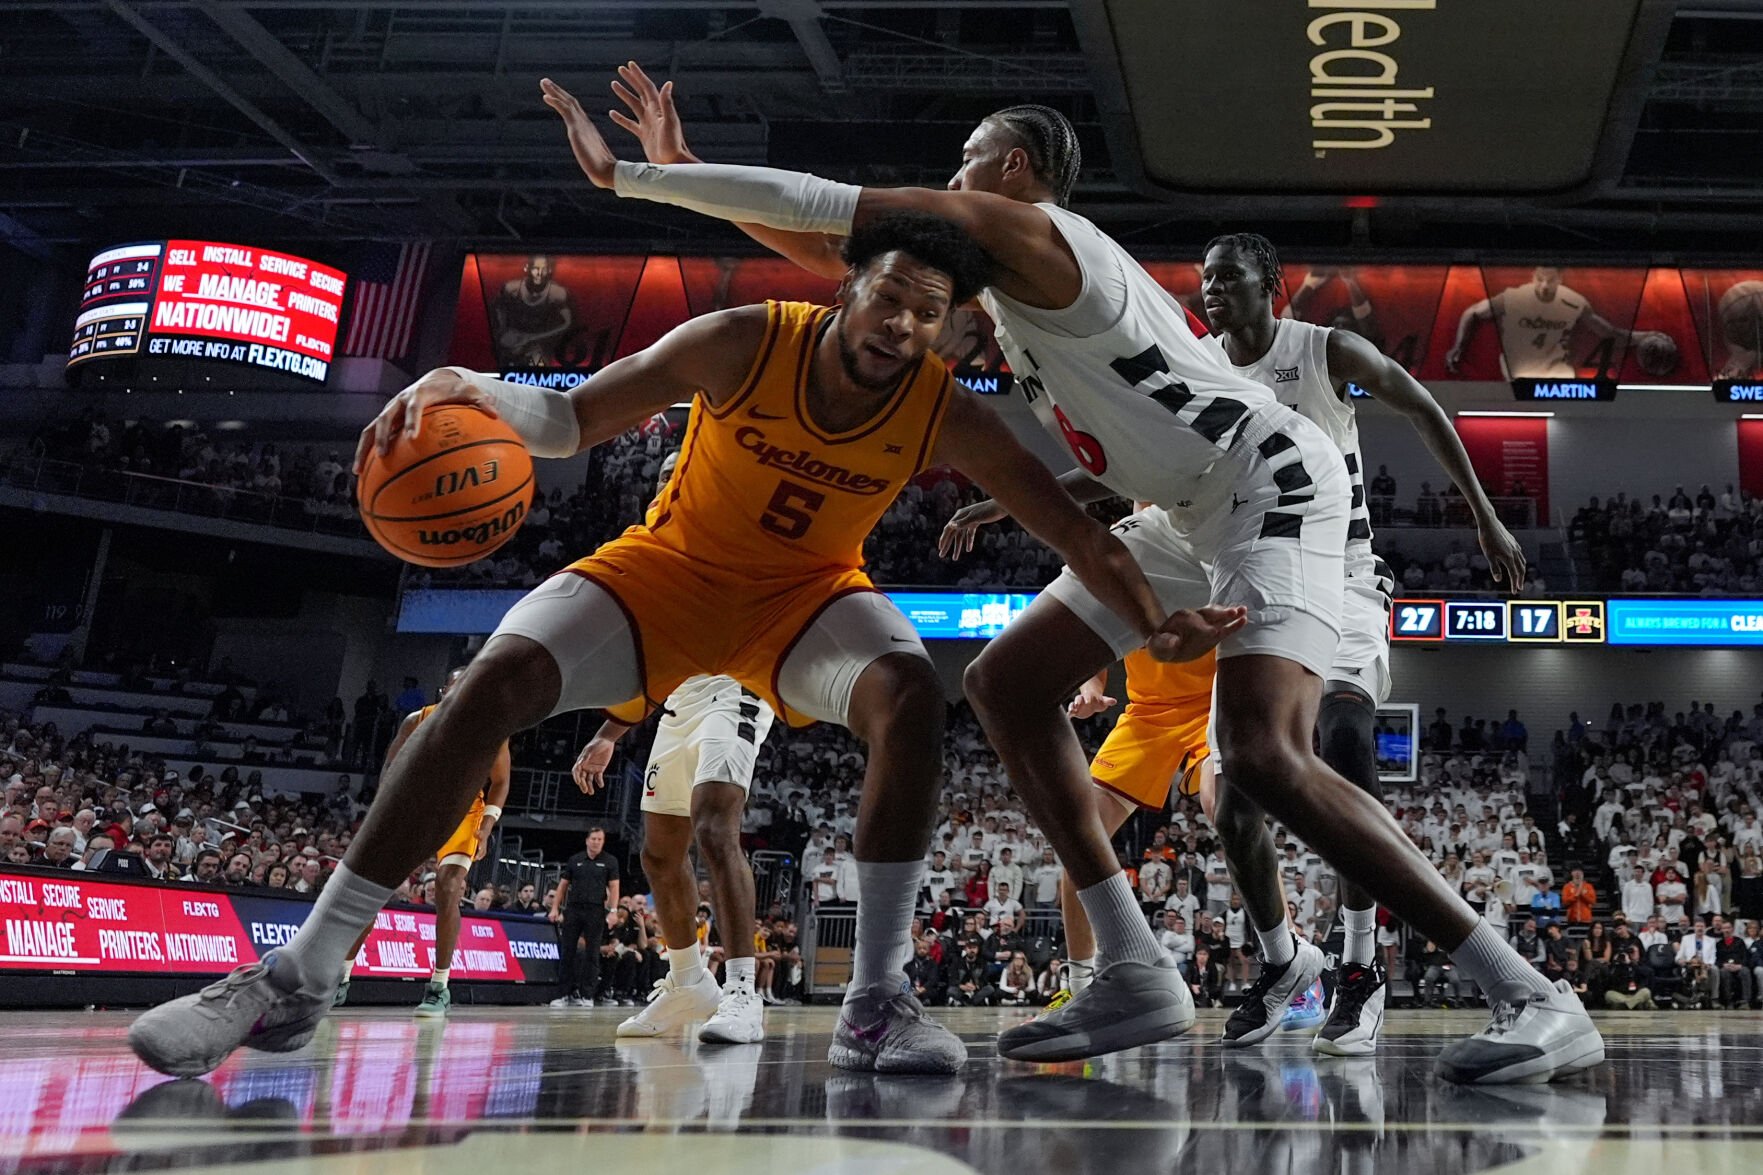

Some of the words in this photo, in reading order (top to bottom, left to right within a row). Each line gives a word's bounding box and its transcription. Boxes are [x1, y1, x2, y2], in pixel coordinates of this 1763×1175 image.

[1306, 0, 1437, 149] ealth
[167, 249, 197, 266] SELL
[202, 245, 253, 267] INSTALL
[259, 255, 308, 280] SERVICE
[309, 270, 344, 297] SECURE
[163, 274, 186, 292] WE
[198, 273, 282, 308] MANAGE
[287, 291, 338, 324] PRINTERS,
[155, 301, 291, 342] NATIONWIDE!
[148, 338, 171, 354] GET
[171, 339, 205, 356] MORE
[204, 342, 230, 359] INFO
[230, 345, 247, 361] AT
[247, 343, 328, 382] FLEXTG.COM
[1533, 383, 1597, 398] MARTIN
[1730, 385, 1763, 400] SWE
[735, 426, 890, 496] Cyclones
[418, 500, 525, 545] Wilson
[759, 479, 826, 540] 5
[1400, 607, 1435, 631] 27
[1456, 610, 1496, 630] 7:18
[1520, 609, 1552, 632] 17
[42, 883, 82, 908] SECURE
[86, 897, 128, 921] SERVICE
[183, 900, 220, 918] FLEXTG
[6, 919, 79, 957] MANAGE
[98, 929, 165, 964] PRINTERS,
[165, 932, 239, 963] NATIONWIDE!
[393, 914, 418, 932] SECURE
[377, 940, 419, 968] MANAGE
[508, 940, 560, 960] FLEXTG.COM
